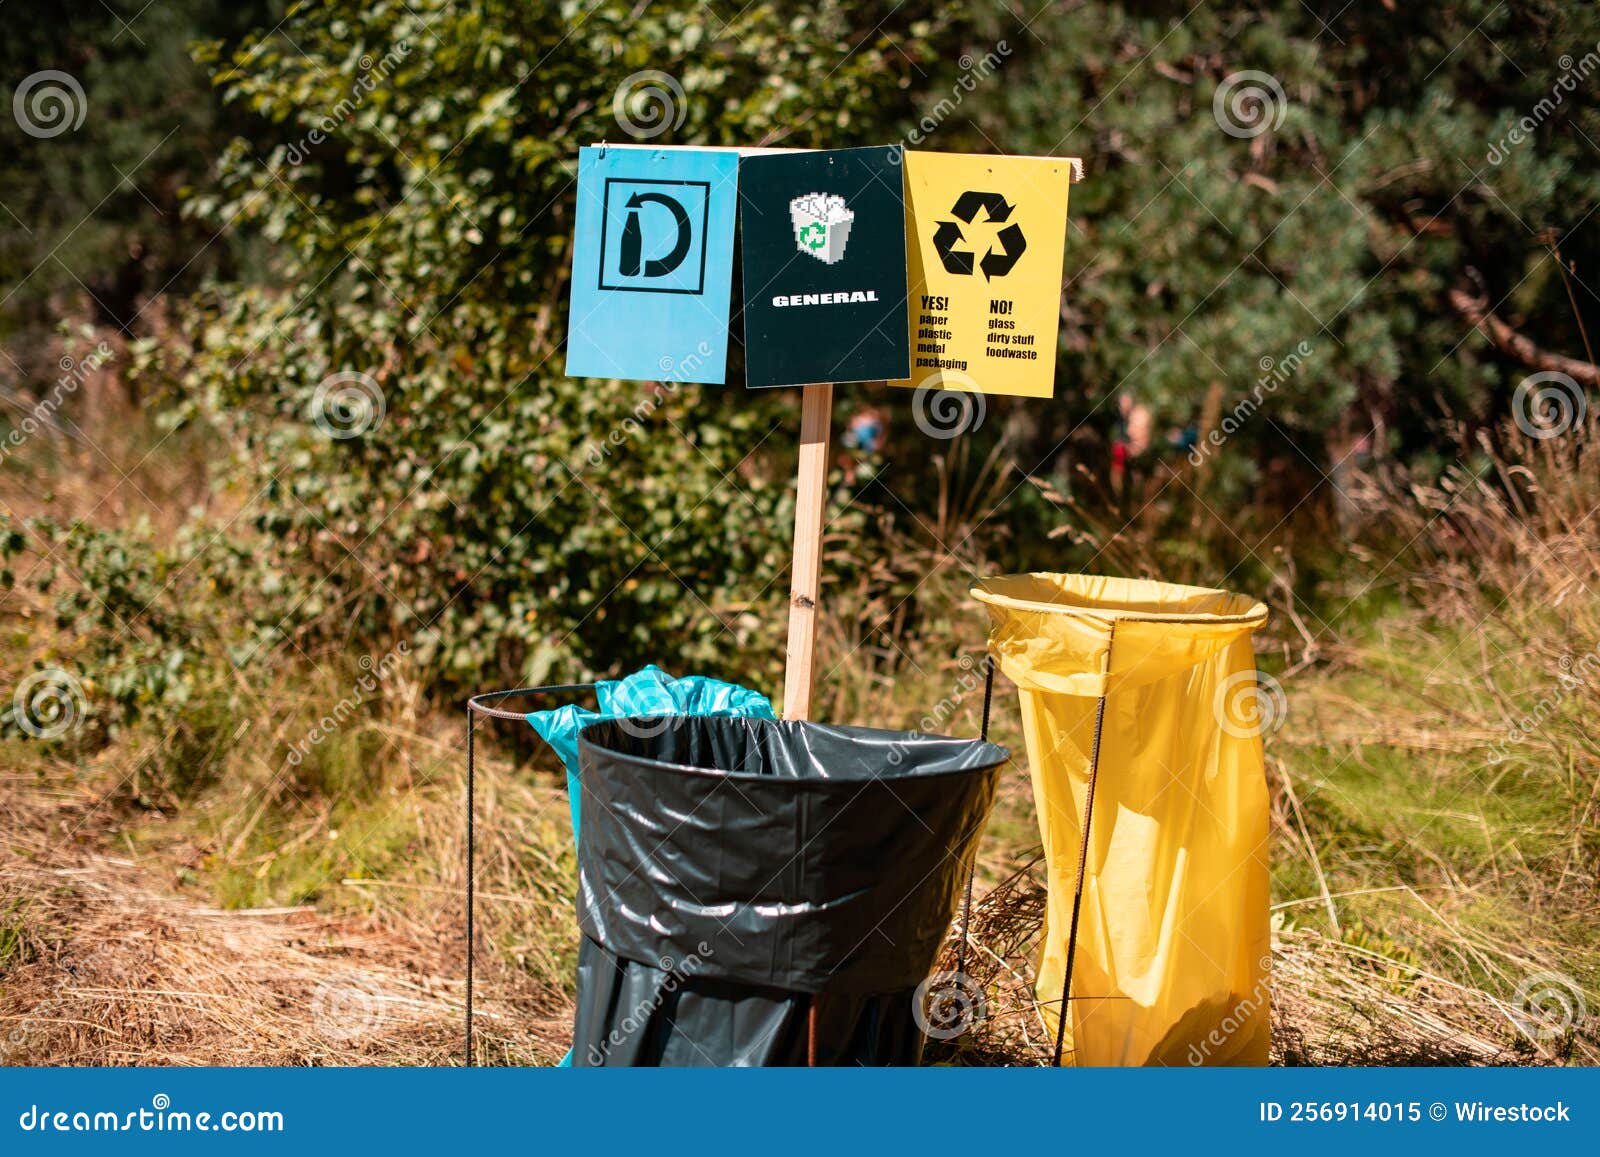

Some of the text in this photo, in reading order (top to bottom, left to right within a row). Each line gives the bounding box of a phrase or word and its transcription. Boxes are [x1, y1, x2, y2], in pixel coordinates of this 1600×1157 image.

[772, 290, 879, 307] GENERAL
[921, 295, 949, 311] YES!
[989, 299, 1013, 315] NO!
[919, 314, 948, 326] paper
[988, 318, 1015, 330] glass
[918, 328, 952, 340] plastic
[987, 332, 1035, 345] dirty stuff
[917, 342, 945, 354] metal
[986, 346, 1037, 360] foodwaste
[916, 356, 967, 371] packaging
